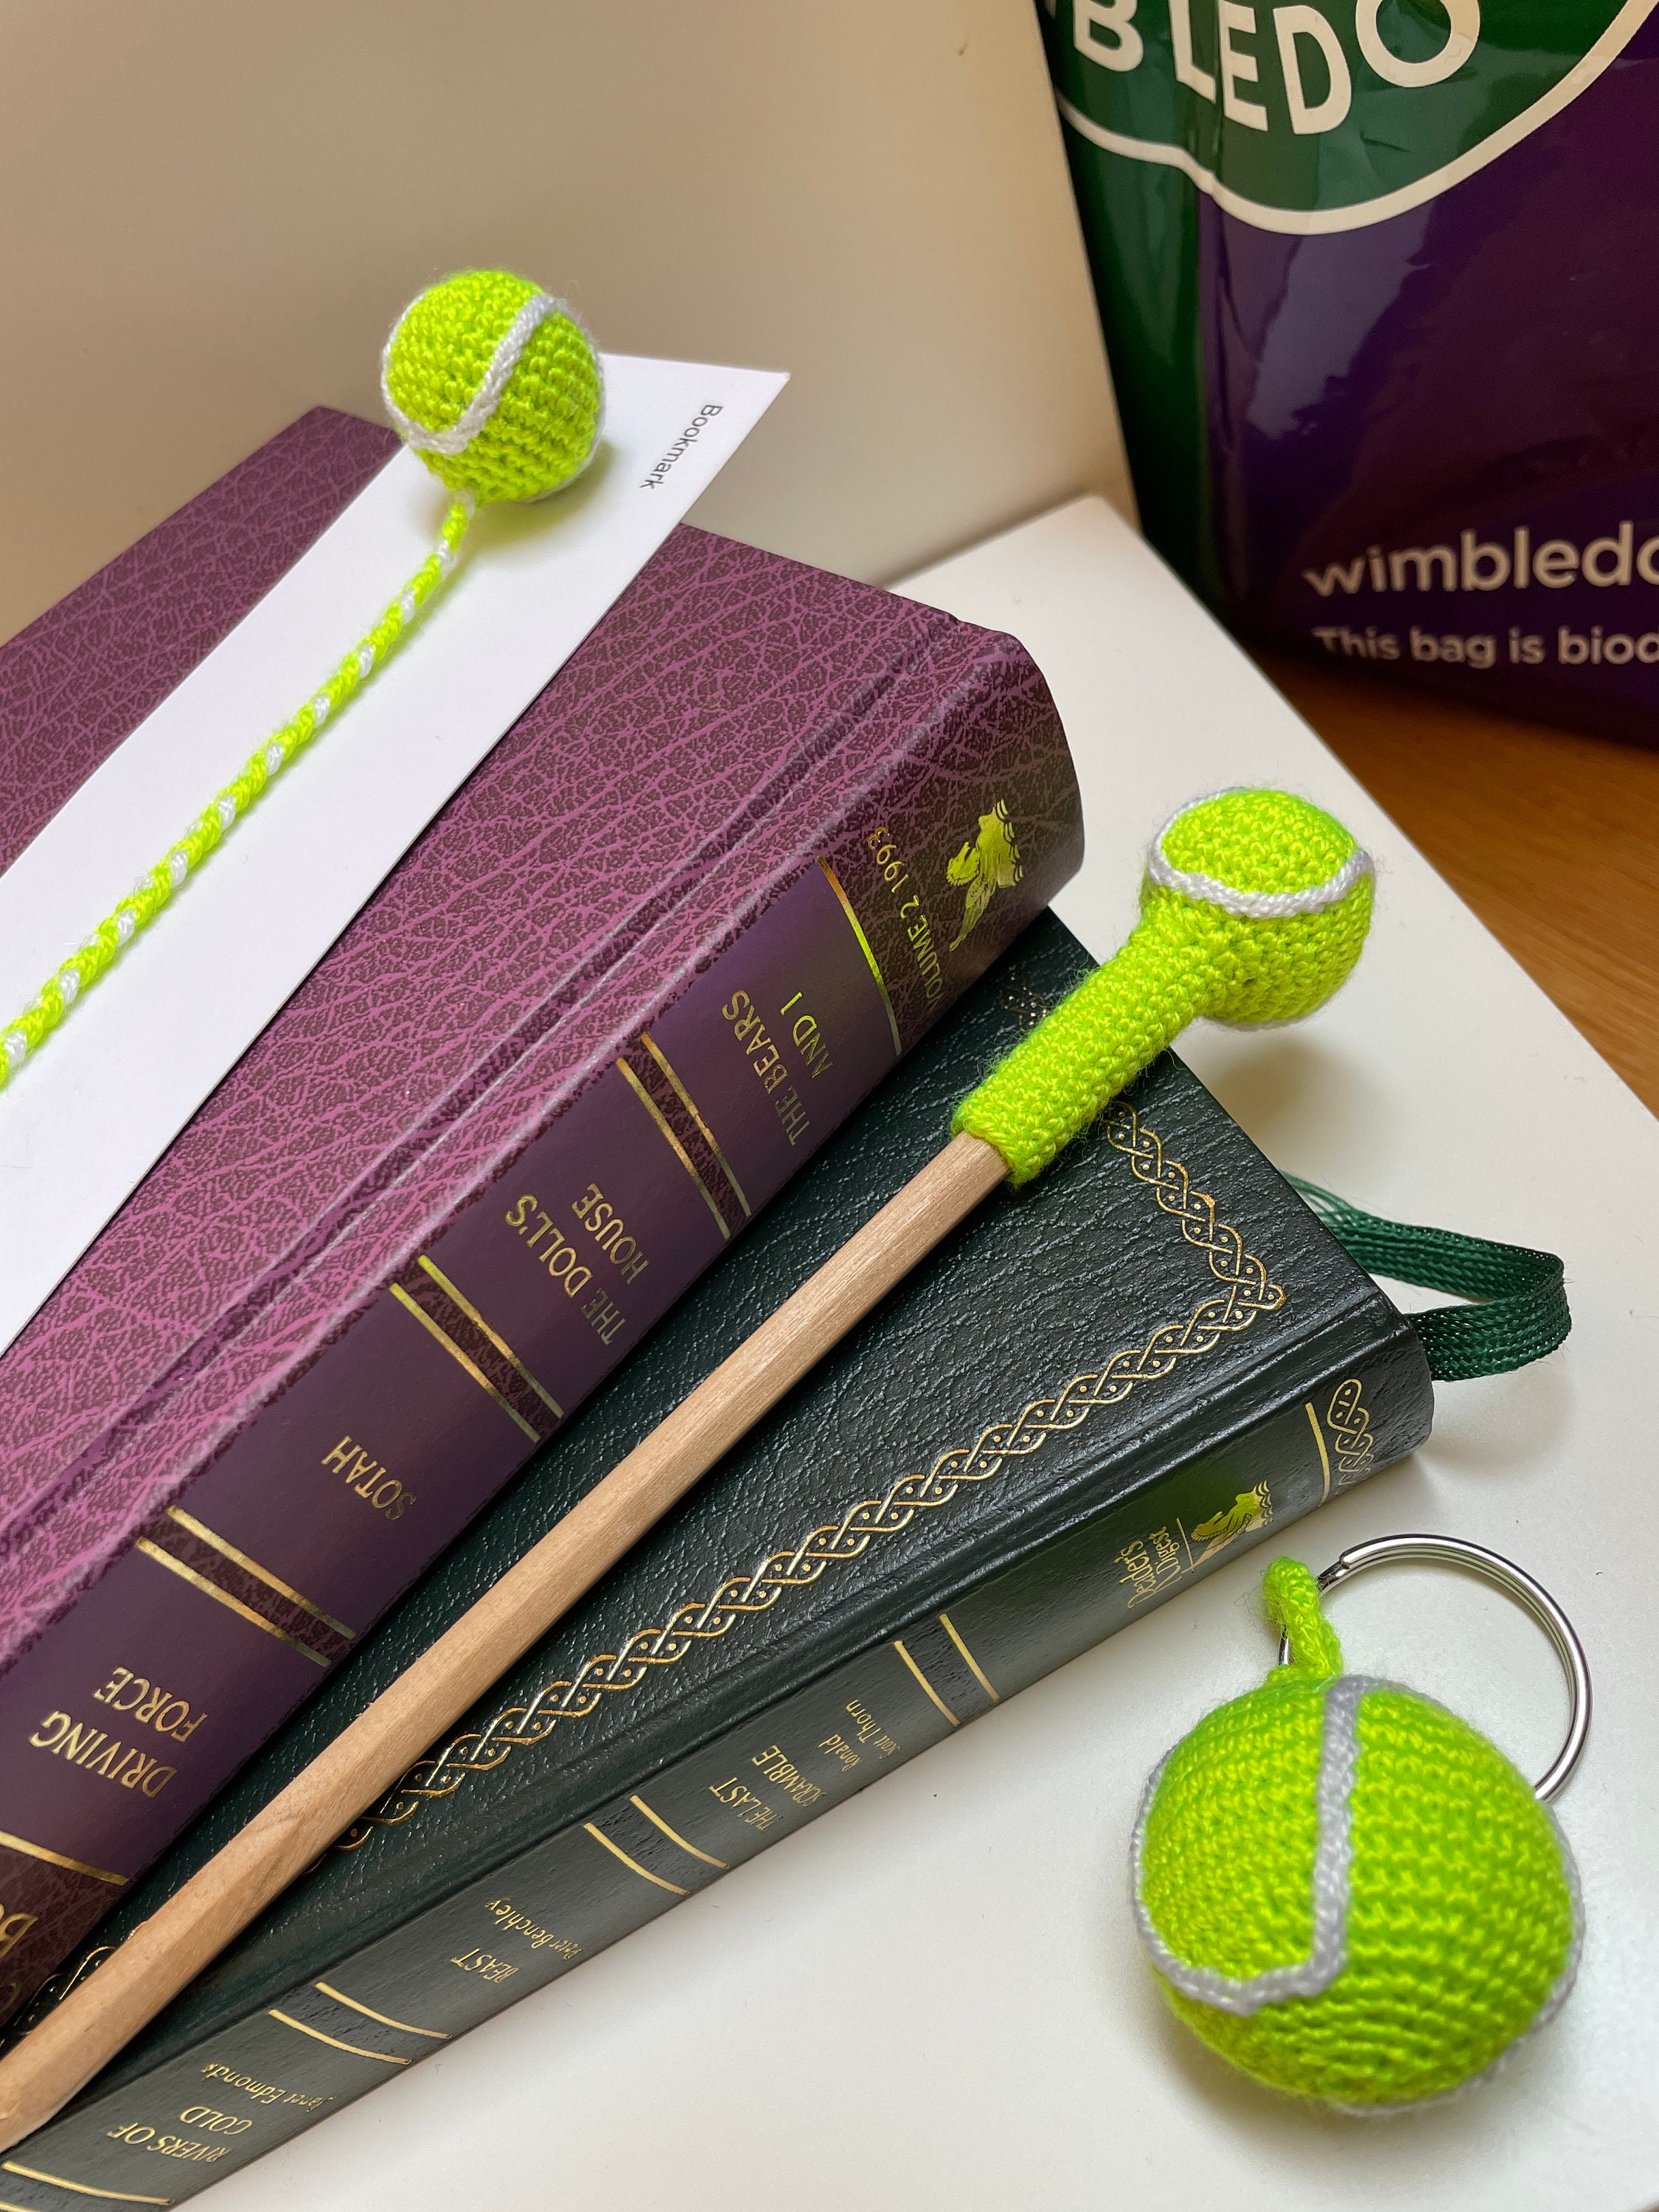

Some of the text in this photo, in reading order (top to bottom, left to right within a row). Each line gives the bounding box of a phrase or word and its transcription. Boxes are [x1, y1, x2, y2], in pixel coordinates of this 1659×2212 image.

[1044, 0, 1481, 134] BLEDO
[639, 405, 723, 489] Bookmark
[1312, 625, 1400, 661] This
[1410, 625, 1497, 669] bag
[1509, 626, 1545, 664] is
[867, 826, 945, 1012] VOLUME 2 1993
[721, 990, 810, 1147] THE BEARS
[780, 991, 833, 1079] AND I
[571, 1183, 649, 1284] HOUSE
[505, 1194, 627, 1346] THE DOLL'S
[321, 1435, 417, 1520] SOTAH
[1113, 1540, 1182, 1609] Reader's
[1149, 1526, 1180, 1575] Digest
[93, 1666, 208, 1742] FORCE
[845, 1699, 882, 1744] Thorn
[28, 1710, 178, 1798] DRIVING
[751, 1745, 826, 1806] SCRAMBLE
[818, 1733, 862, 1773] Ronald
[709, 1776, 782, 1832] THE LAST
[484, 1897, 554, 1949] Benchley
[450, 1947, 519, 1983] BEAST
[201, 2062, 288, 2104] Edmonds
[106, 2121, 232, 2163] RIVERS OF
